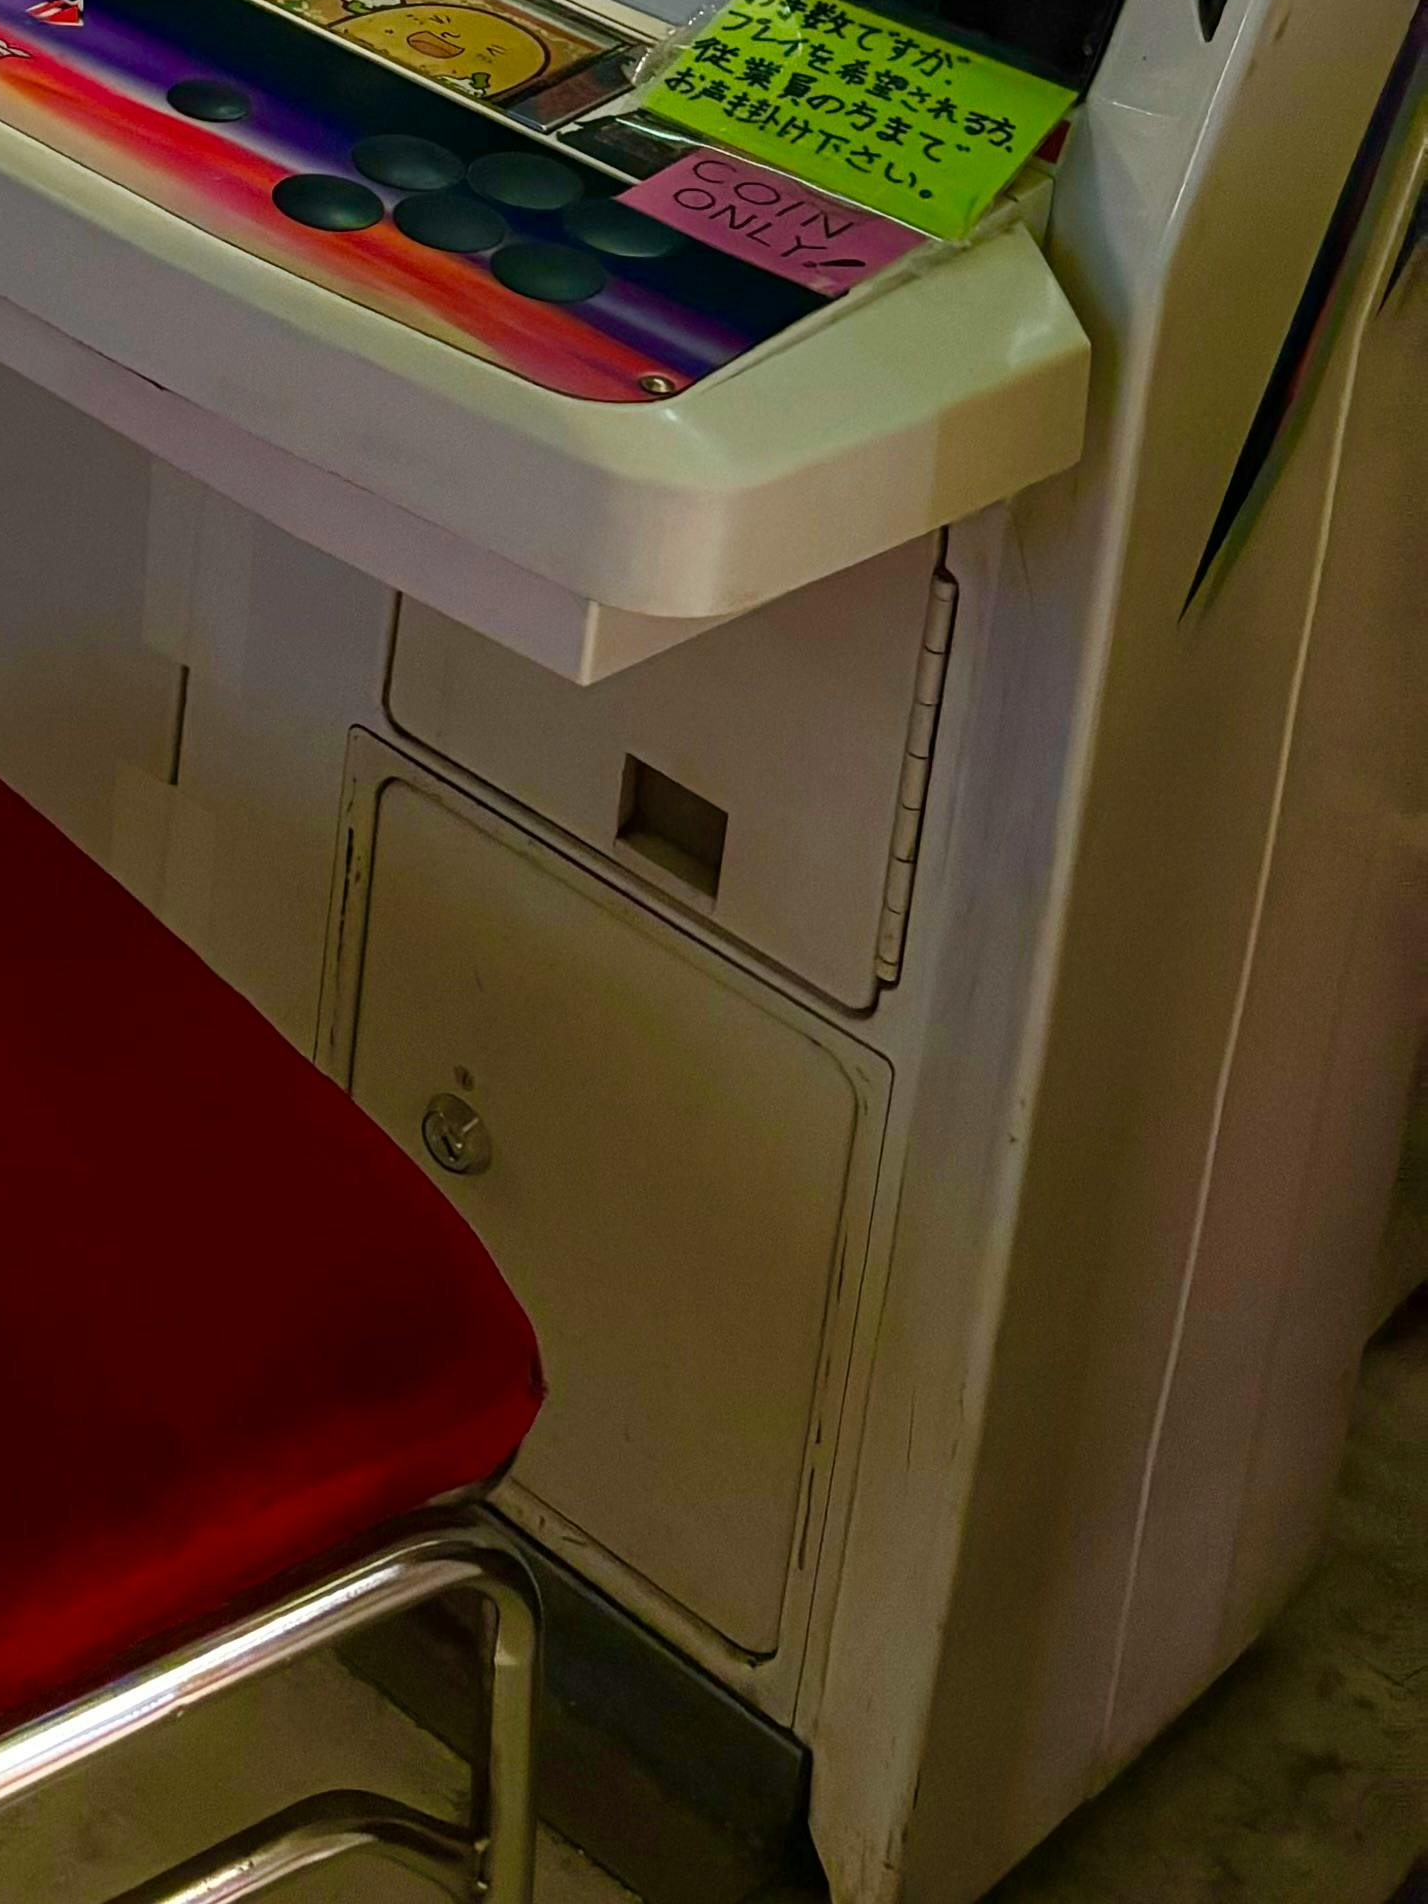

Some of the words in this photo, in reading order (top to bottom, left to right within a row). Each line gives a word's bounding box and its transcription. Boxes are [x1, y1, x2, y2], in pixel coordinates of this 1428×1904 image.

[664, 67, 934, 201] お声掛け下さい。
[690, 37, 972, 164] 従業員の方まで
[672, 186, 867, 269] ONLY!
[691, 158, 855, 242] COIN
